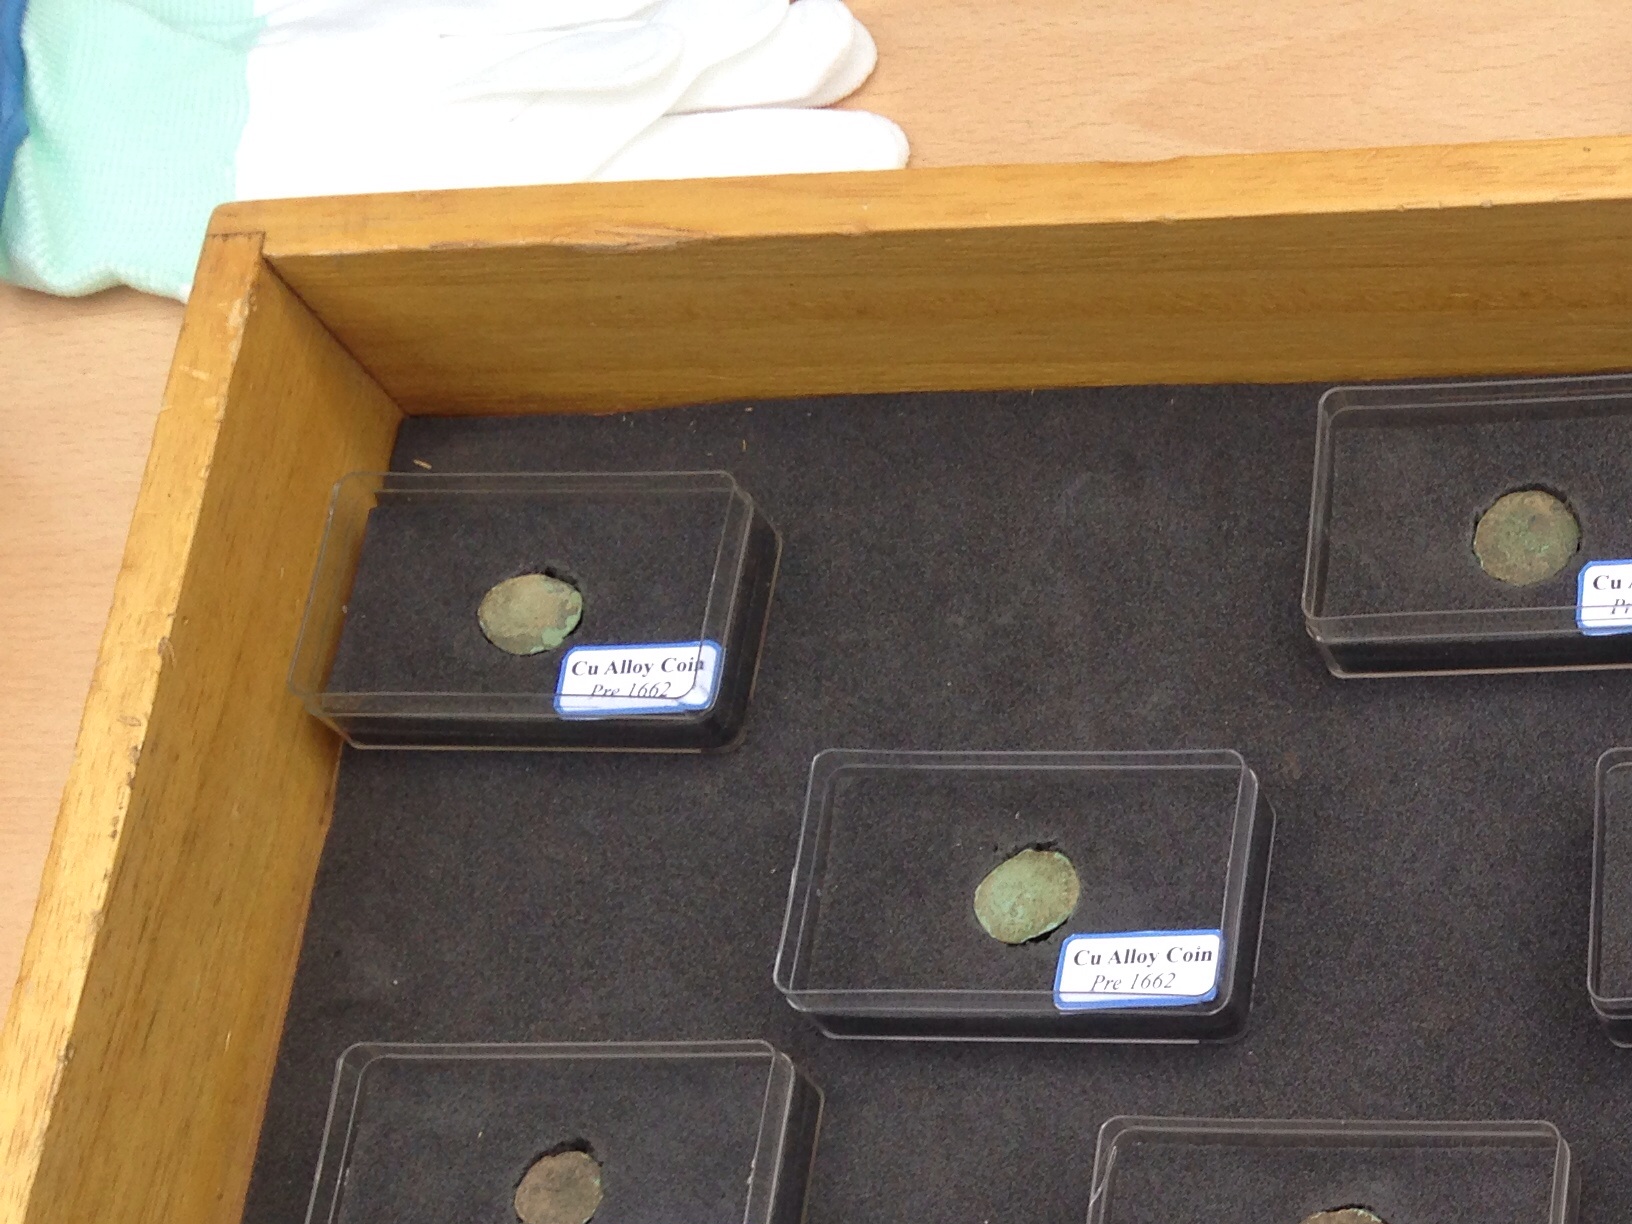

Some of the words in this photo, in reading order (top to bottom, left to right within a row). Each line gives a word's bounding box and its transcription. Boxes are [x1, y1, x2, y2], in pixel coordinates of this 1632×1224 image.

[1592, 574, 1620, 590] Cu
[571, 660, 598, 676] Cu
[602, 658, 654, 677] Alloy
[660, 656, 704, 673] Coin
[592, 682, 622, 697] Pre
[627, 681, 671, 697] 1662
[1074, 951, 1101, 965] Cu
[1107, 947, 1163, 967] Alloy
[1168, 947, 1212, 962] Coin
[1091, 975, 1121, 991] Pre
[1131, 973, 1175, 989] 1662
